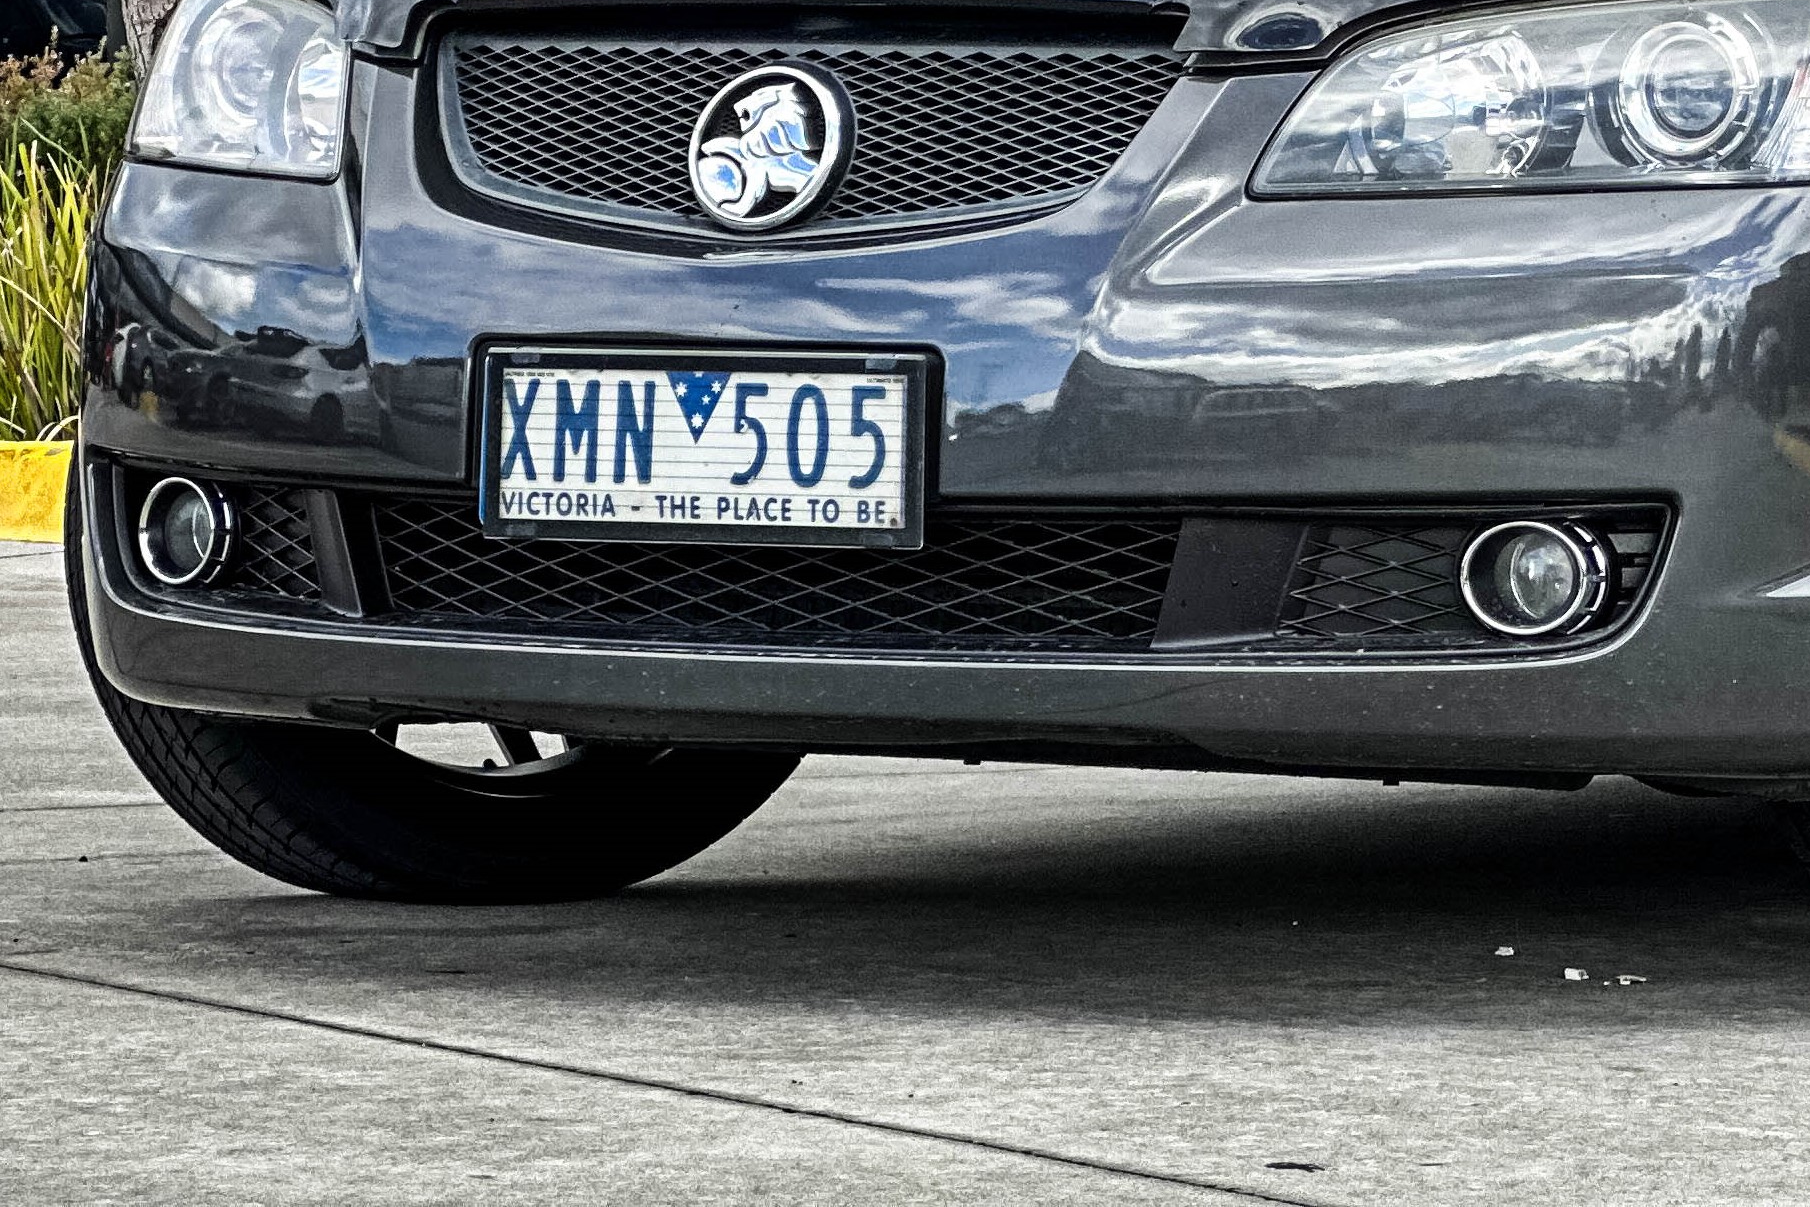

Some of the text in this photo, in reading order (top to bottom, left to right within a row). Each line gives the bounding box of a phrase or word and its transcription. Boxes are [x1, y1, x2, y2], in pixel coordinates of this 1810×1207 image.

[501, 378, 887, 490] XMN 505
[501, 491, 616, 517] VICTORIA
[656, 495, 701, 519] THE
[717, 497, 792, 522] PLACE
[807, 499, 841, 524] TO
[857, 500, 886, 525] BE
